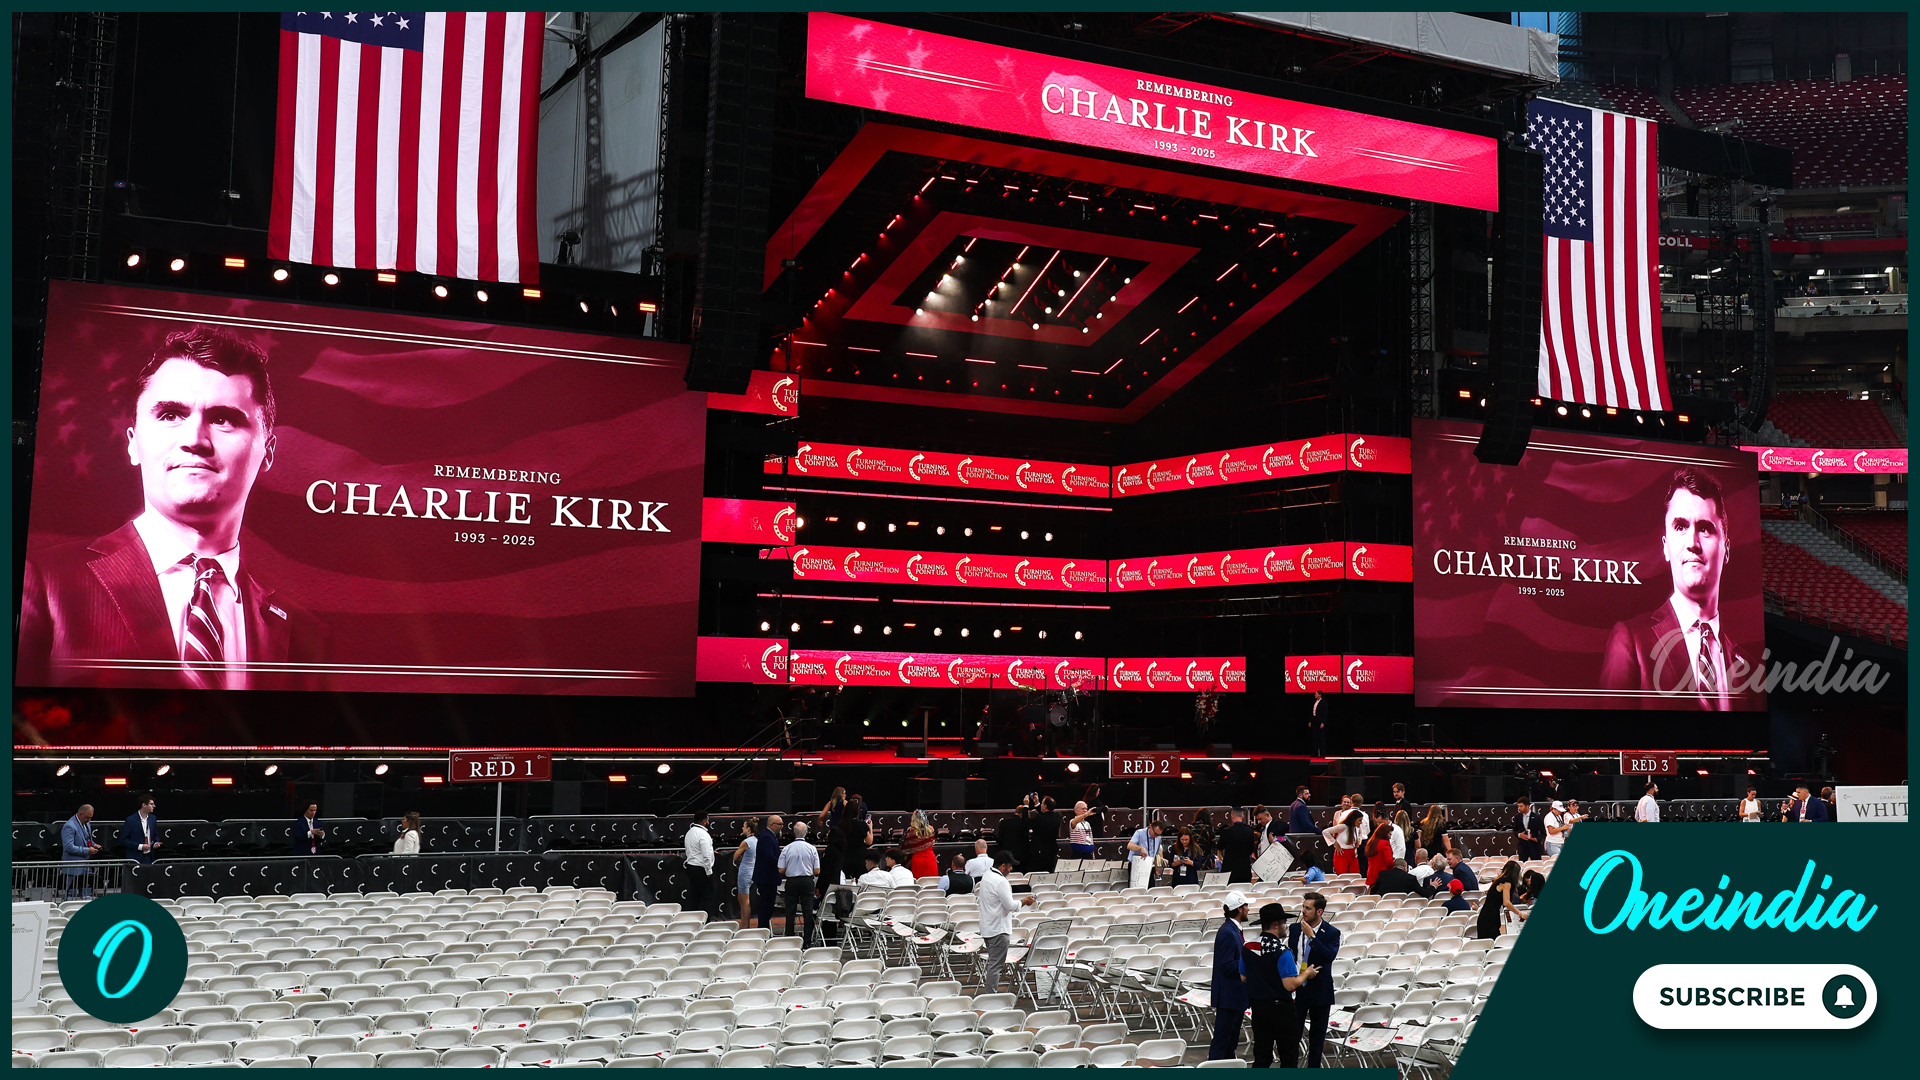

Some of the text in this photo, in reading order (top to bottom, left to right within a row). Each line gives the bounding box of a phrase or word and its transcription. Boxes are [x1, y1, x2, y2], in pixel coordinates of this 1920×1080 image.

[1136, 79, 1233, 106] REMEMBERING
[1042, 83, 1318, 158] CHARLIE KIRK
[1154, 140, 1178, 152] 1993
[1190, 146, 1216, 158] 2025
[1659, 236, 1692, 247] COLL
[1307, 449, 1330, 457] TURNING
[1323, 453, 1342, 462] ACTION
[434, 464, 561, 484] REMEMBERING
[306, 480, 671, 532] CHARLIE KIRK
[454, 532, 485, 544] 1993
[503, 534, 535, 546] 2025
[1504, 536, 1577, 550] REMEMBERING
[1433, 549, 1642, 584] CHARLIE KIRK
[1518, 587, 1536, 595] 1993
[1546, 588, 1565, 596] 2025
[469, 760, 534, 777] RED 1
[1123, 760, 1169, 773] RED 2
[1632, 760, 1668, 771] RED 3
[1853, 802, 1908, 817] WHIT
